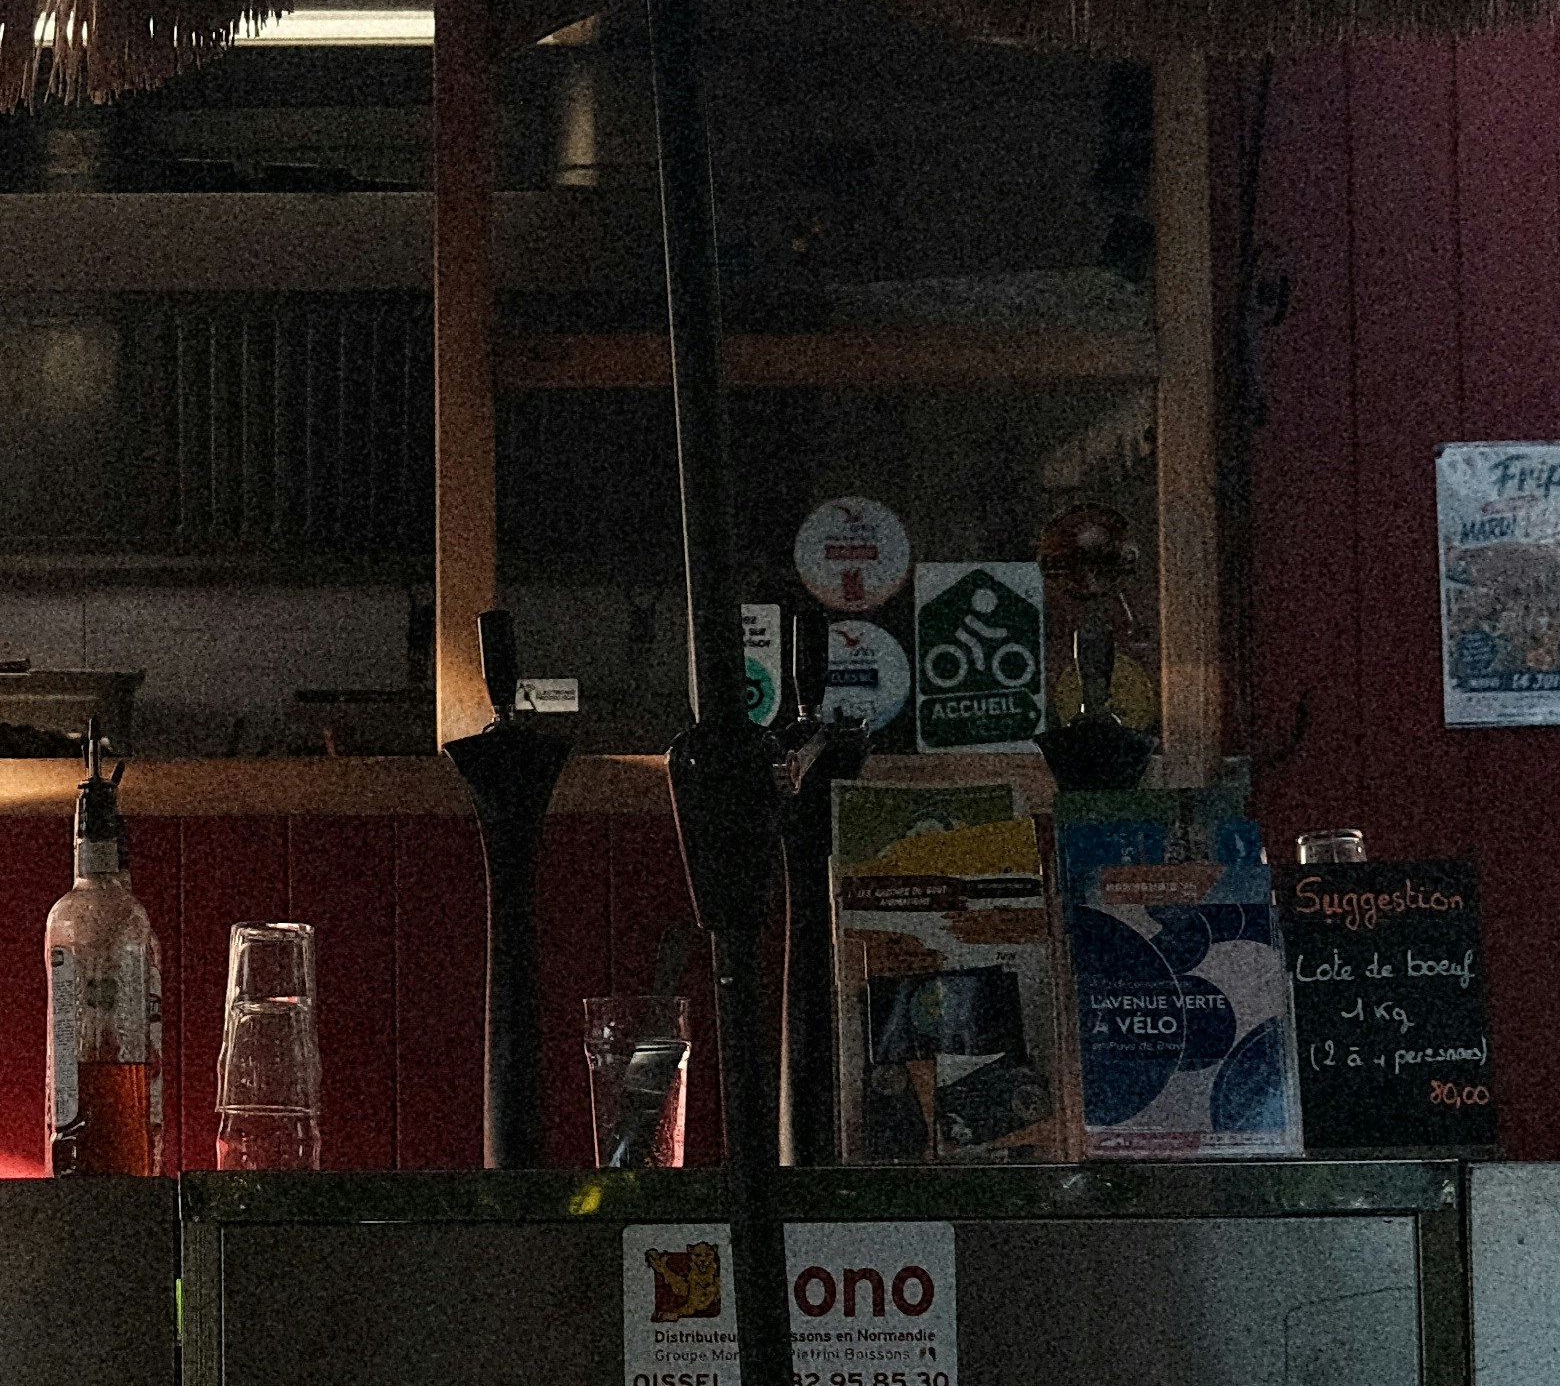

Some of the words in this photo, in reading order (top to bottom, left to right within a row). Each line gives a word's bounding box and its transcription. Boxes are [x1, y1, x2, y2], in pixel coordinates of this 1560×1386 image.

[932, 697, 1023, 720] ACCUEIL
[1295, 876, 1464, 930] Suggestion
[1365, 952, 1394, 979] de
[1407, 949, 1476, 990] boeuf
[1090, 994, 1167, 1009] L'AVENUE
[1172, 994, 1226, 1009] VERTE
[1116, 1011, 1178, 1034] VÉLO
[1429, 1079, 1491, 1109] 80,00
[835, 1332, 853, 1343] en
[857, 1328, 936, 1343] Normandie
[654, 1349, 706, 1364] Groupe
[844, 1347, 910, 1362] Boissons
